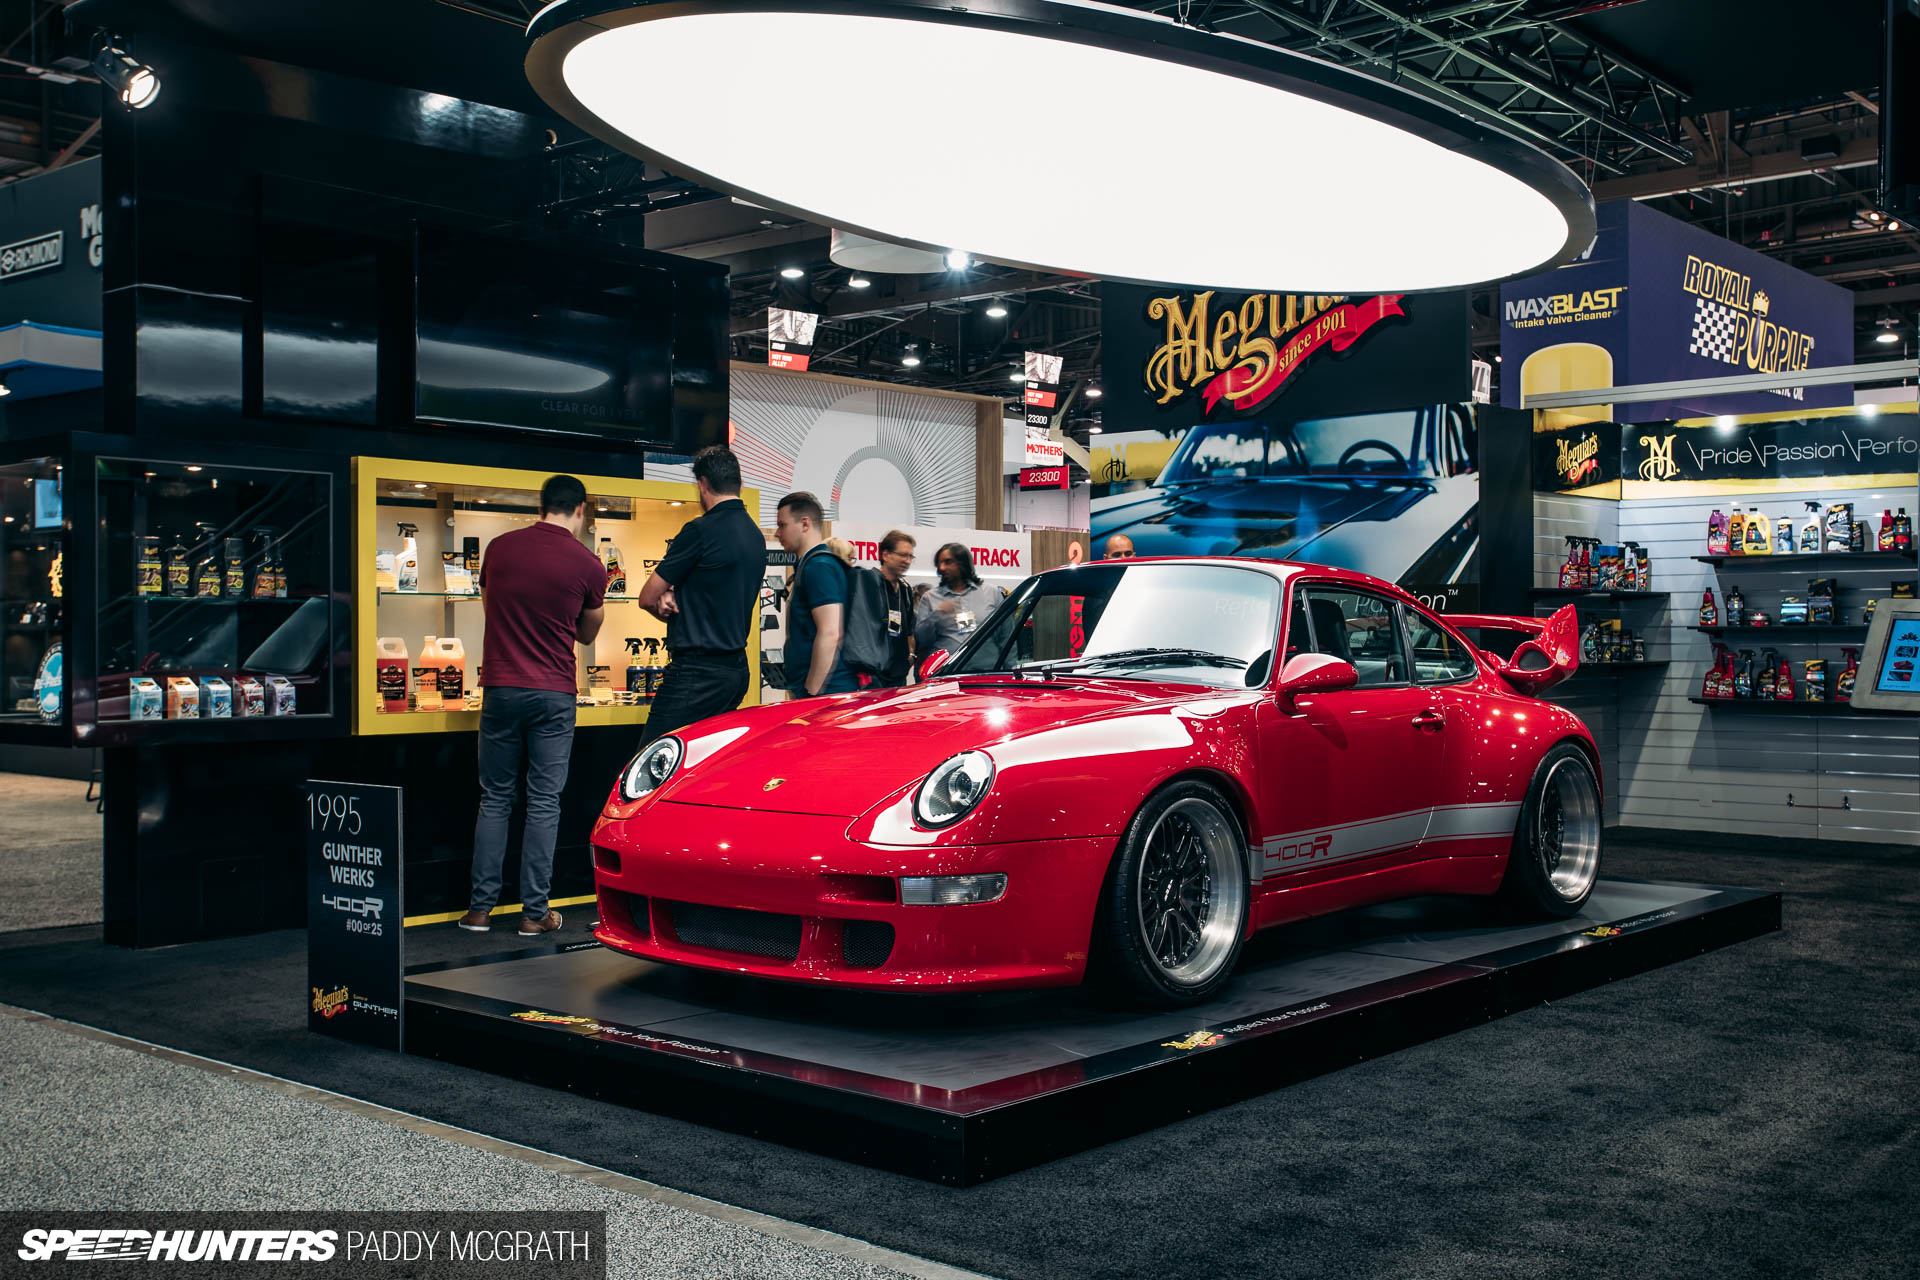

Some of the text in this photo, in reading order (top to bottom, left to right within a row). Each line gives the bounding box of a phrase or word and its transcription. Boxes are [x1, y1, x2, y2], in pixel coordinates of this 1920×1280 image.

[1683, 254, 1751, 311] ROYAL
[1515, 310, 1613, 329] Intake Valve Cleaner
[1278, 308, 1347, 373] since 1901
[1731, 312, 1810, 374] PURPLE
[1027, 414, 1048, 424] 23300
[1026, 443, 1063, 456] MOTHERS
[1857, 436, 1918, 462] Perfo
[1029, 471, 1060, 483] 23300
[970, 547, 1020, 567] TRACK
[307, 793, 362, 836] 1995
[322, 842, 383, 867] GUNTHER
[1265, 834, 1332, 862] 400R
[330, 865, 375, 888] WERKS
[322, 894, 384, 920] 400R
[352, 1000, 398, 1016] GUNTHER
